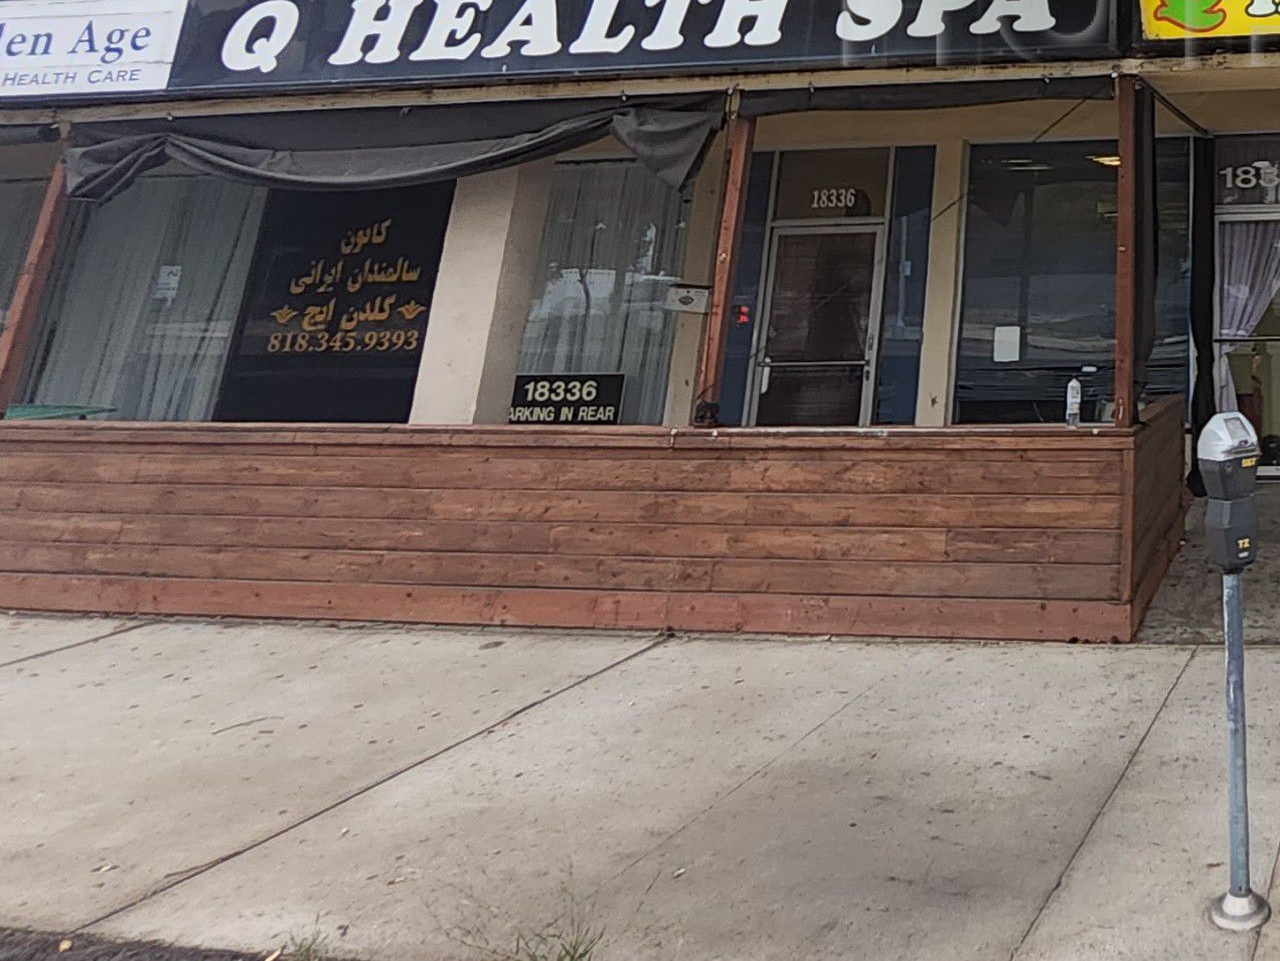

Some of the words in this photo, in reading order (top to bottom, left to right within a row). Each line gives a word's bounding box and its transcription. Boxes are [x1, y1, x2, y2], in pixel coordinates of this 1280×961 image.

[67, 19, 152, 64] Age
[221, 0, 300, 73] Q
[2, 69, 77, 87] HEALTH
[87, 69, 142, 84] CARE
[811, 188, 856, 208] 18336
[267, 330, 419, 352] 818.345.9393
[524, 380, 598, 402] 18336
[560, 407, 574, 421] IN
[578, 406, 615, 421] REAR
